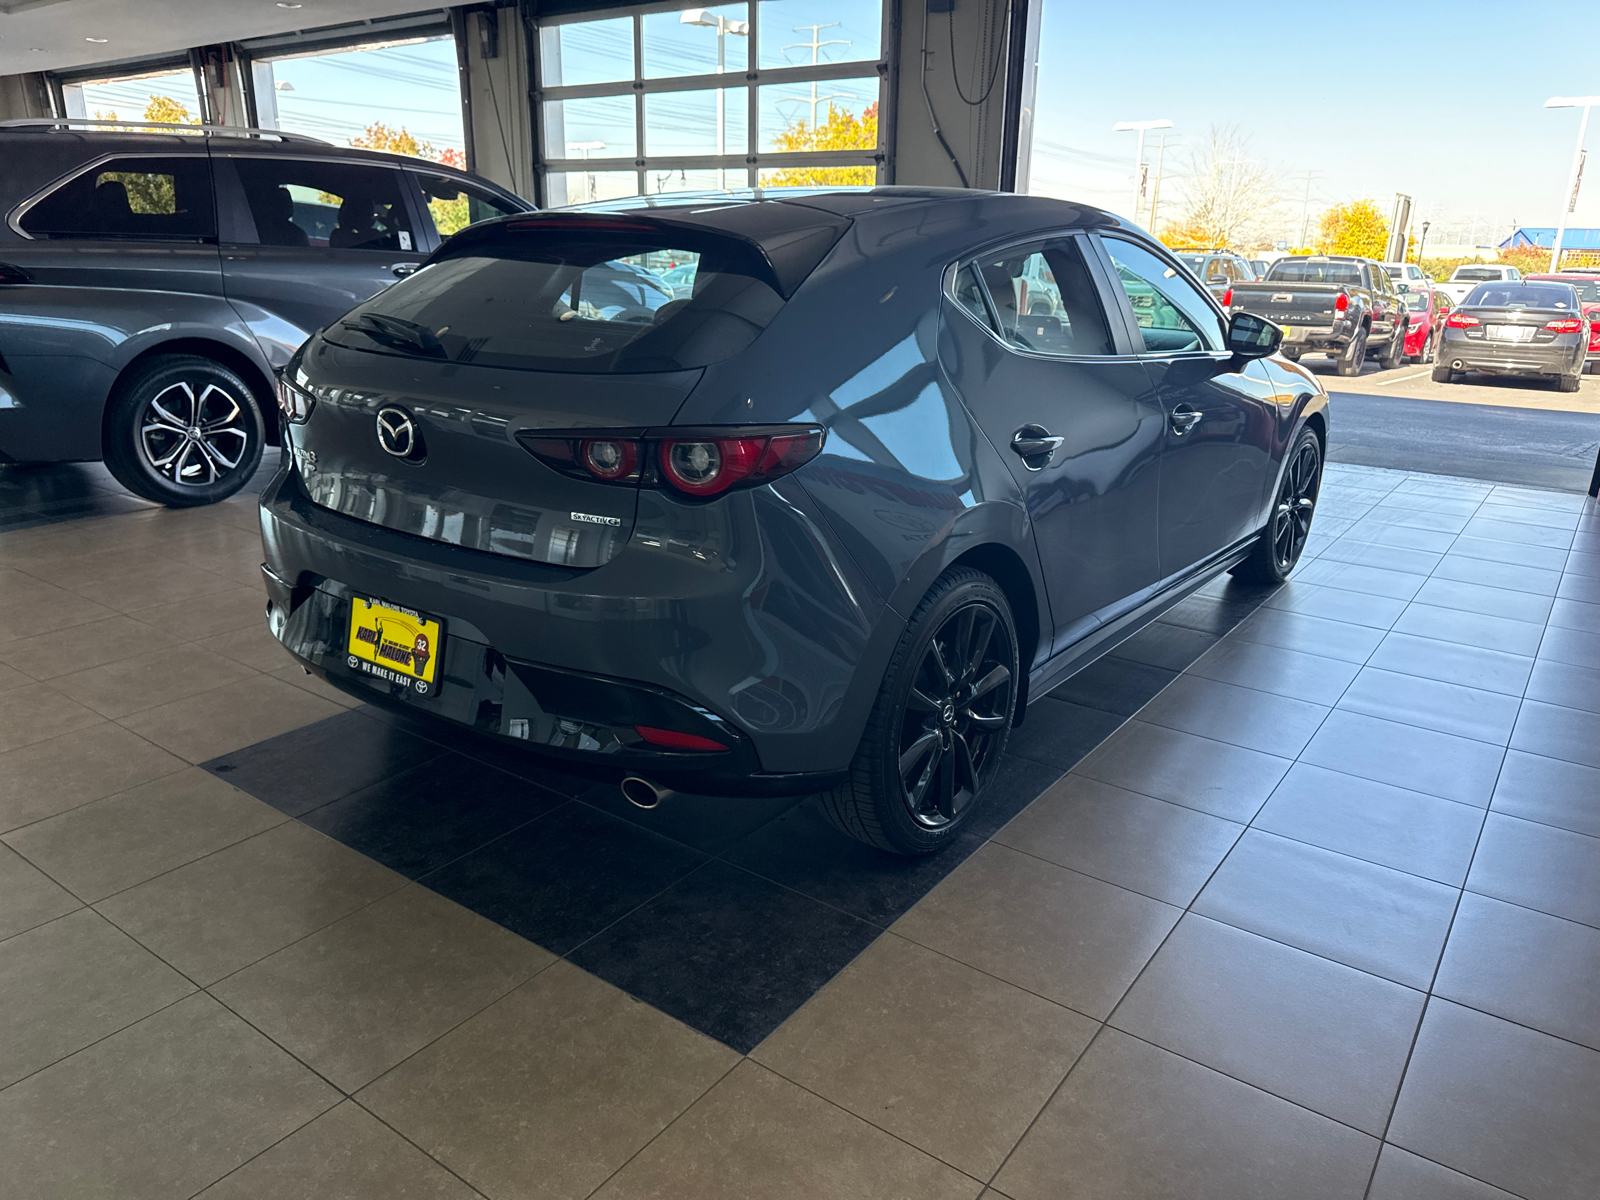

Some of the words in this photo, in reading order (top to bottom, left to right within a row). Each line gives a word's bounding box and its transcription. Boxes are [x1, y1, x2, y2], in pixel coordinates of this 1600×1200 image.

[401, 606, 420, 618] TOYOTA
[356, 625, 378, 645] KARL
[416, 638, 427, 652] 32
[378, 643, 412, 666] MALONE
[362, 661, 372, 672] WE
[371, 665, 388, 679] MAKE
[388, 671, 396, 681] IT
[395, 673, 412, 687] EASY
